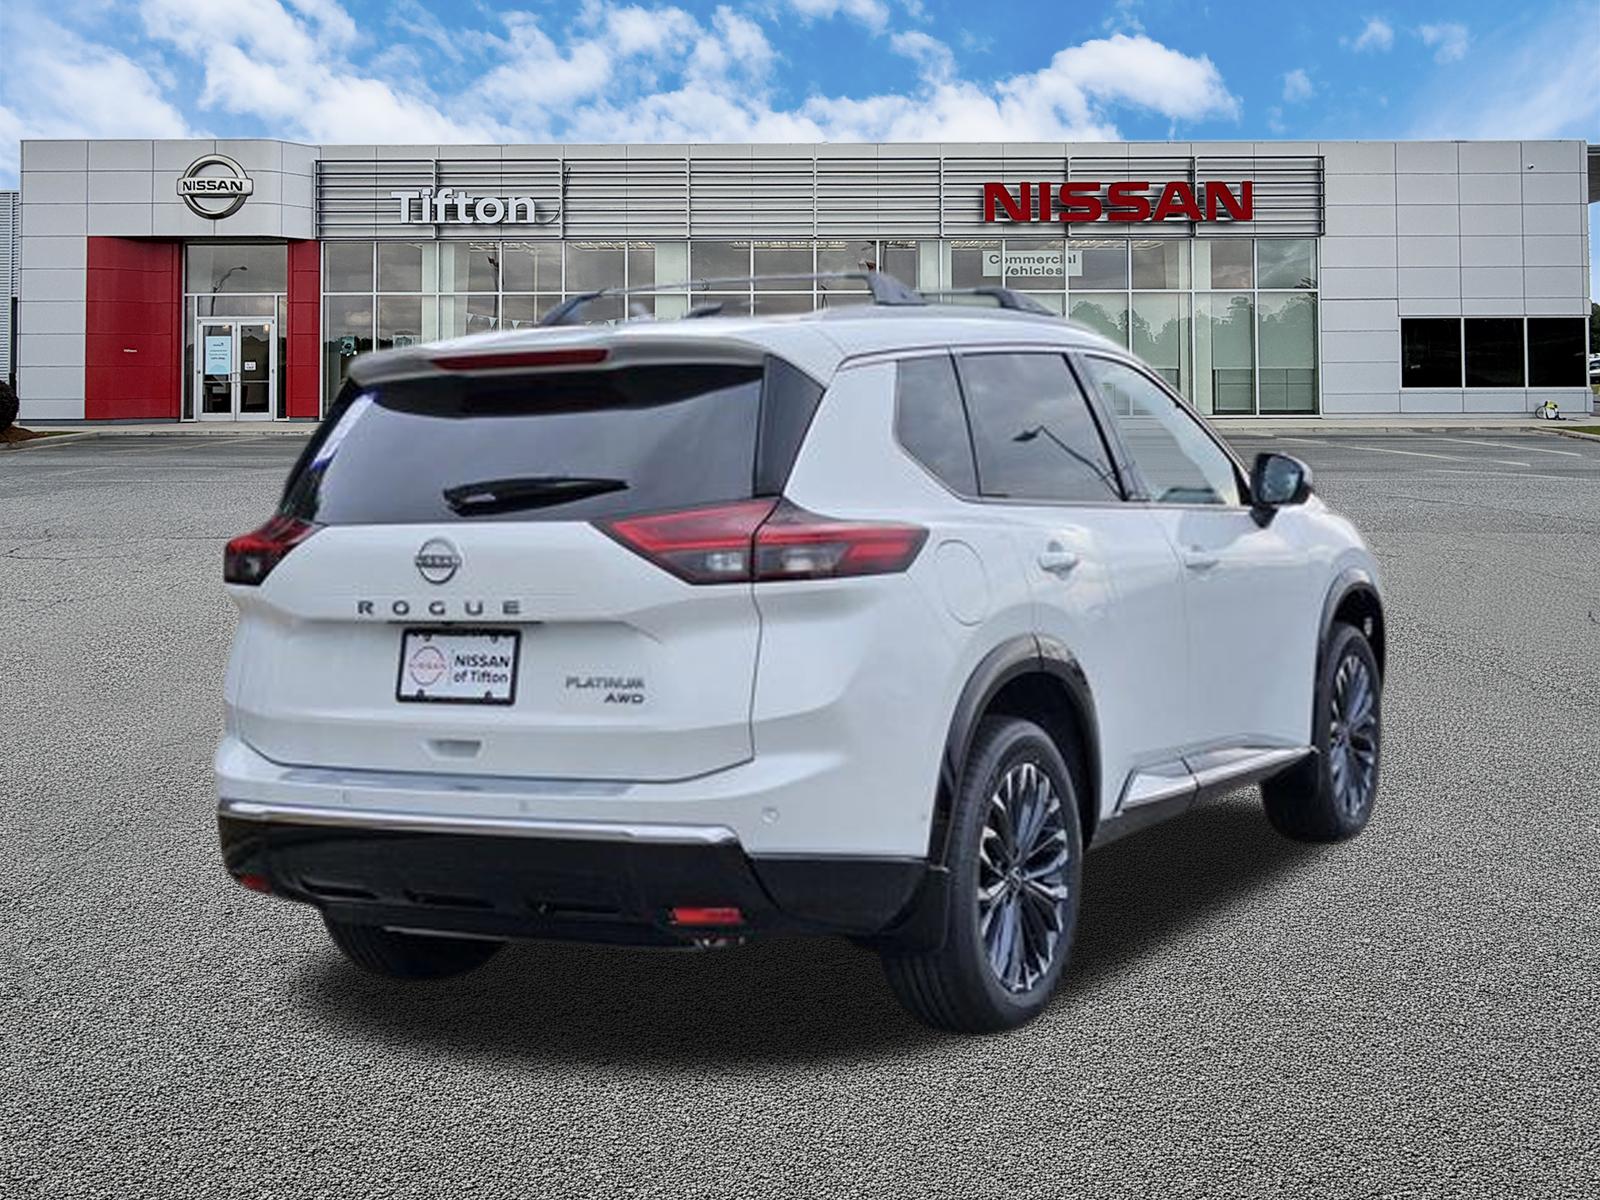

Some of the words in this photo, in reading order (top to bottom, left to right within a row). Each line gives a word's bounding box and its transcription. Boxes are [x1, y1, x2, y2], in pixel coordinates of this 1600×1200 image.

[181, 180, 243, 192] NISSAN
[390, 188, 536, 224] Tifton
[982, 180, 1255, 222] NISSAN
[357, 600, 521, 615] ROGUE
[454, 655, 511, 668] NISSAN
[453, 670, 467, 683] of
[471, 670, 508, 683] Tifton
[565, 676, 645, 689] PLATINUM
[604, 693, 645, 704] AWD
